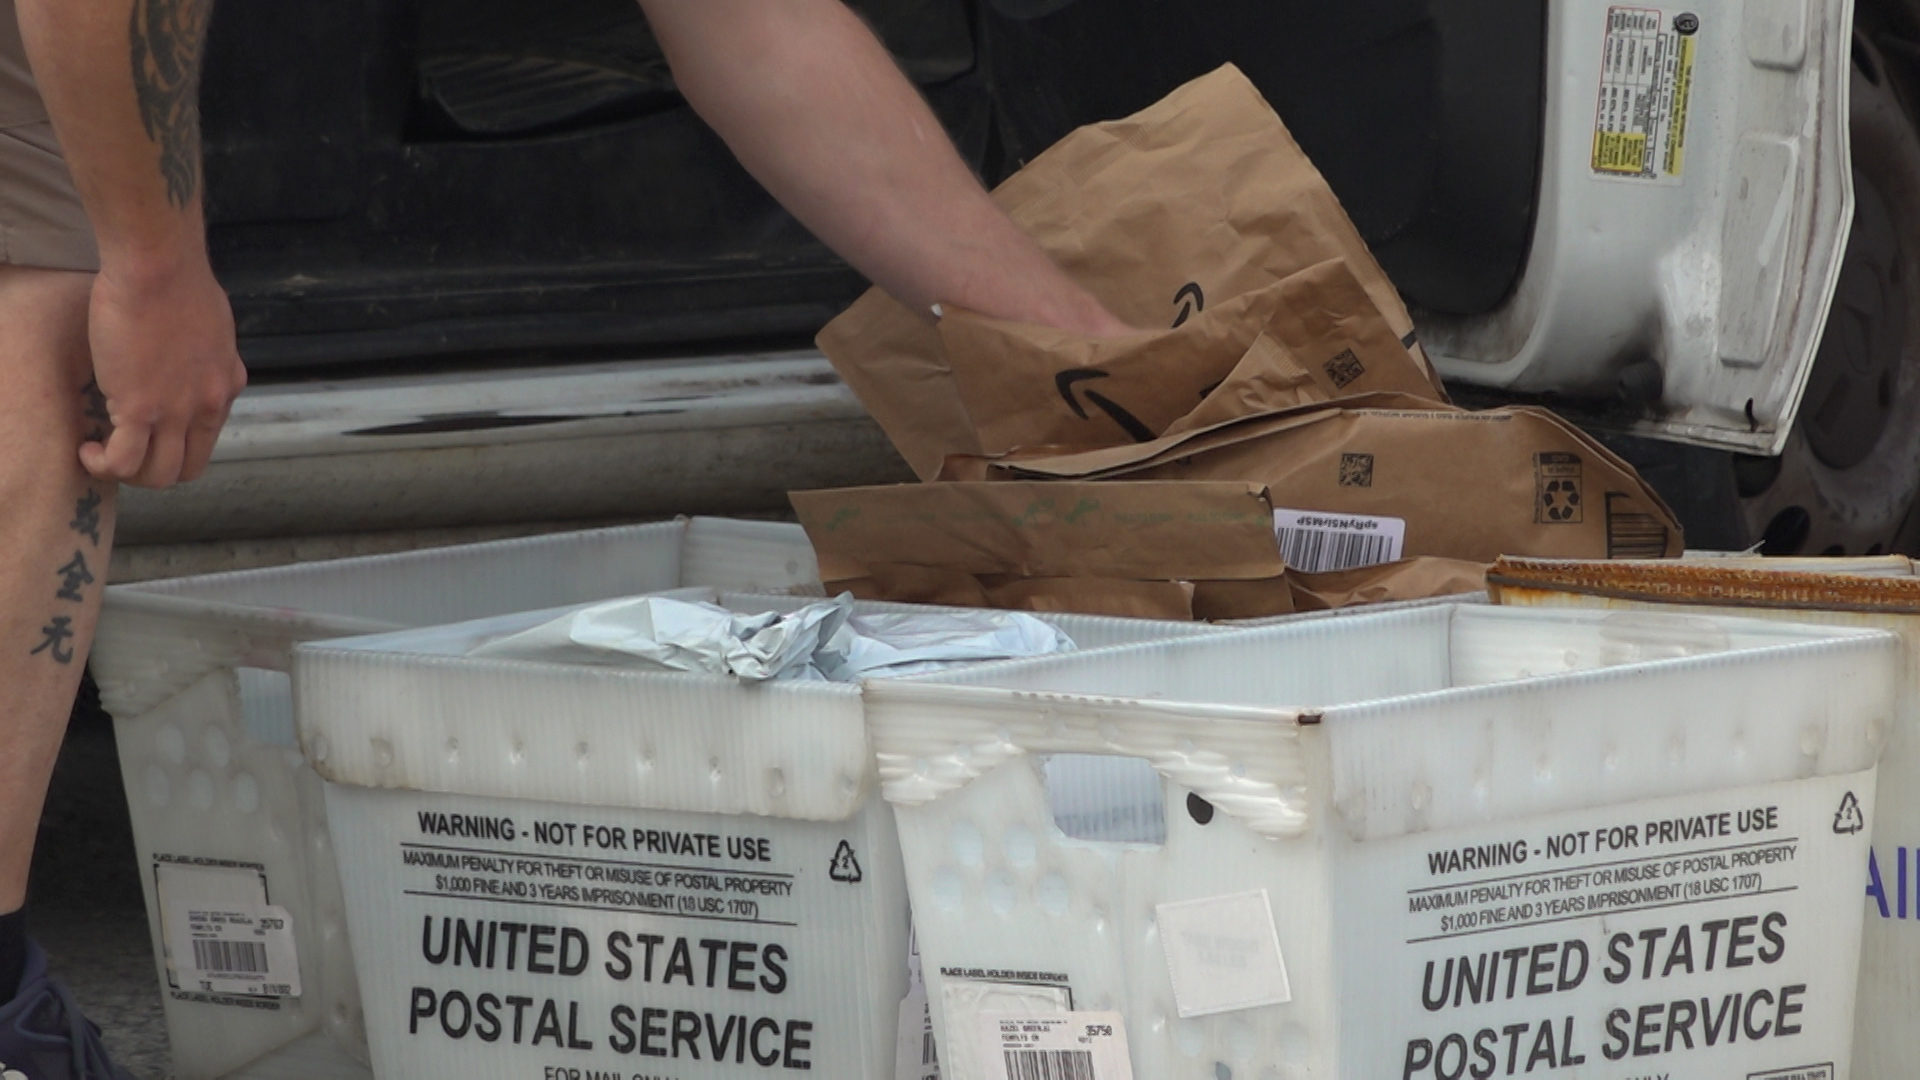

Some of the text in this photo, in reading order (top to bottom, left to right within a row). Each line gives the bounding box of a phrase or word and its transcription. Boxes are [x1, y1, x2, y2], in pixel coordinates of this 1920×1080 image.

[417, 810, 516, 841] WARNING
[534, 820, 577, 846] NOT
[583, 825, 628, 851] FOR
[633, 828, 721, 858] PRIVATE
[727, 836, 771, 862] USE
[1428, 839, 1527, 875] WARNING
[1547, 831, 1590, 859] NOT
[1595, 825, 1639, 851] FOR
[1645, 812, 1731, 845] PRIVATE
[1737, 806, 1779, 833] USE
[403, 851, 793, 896] MAXIMUM PENALTY FOR THEFT OR MISUSE OF POSTAL PROPERTY
[435, 873, 471, 892] $1,000
[473, 878, 500, 894] FINE
[501, 881, 527, 897] AND
[529, 883, 537, 898] 3
[539, 884, 580, 901] YEARS
[582, 887, 675, 909] IMPRISONMENT
[698, 897, 725, 913] USC
[727, 899, 759, 920] 1707)
[1409, 846, 1797, 913] MAXIMUM PENALTY FOR THEFT OR MISUSE OF POSTAL PROPERTY
[1440, 872, 1762, 932] $1,000 FINE AND 3 YEARS IMPRISONMENT (18 USC 1707)
[1866, 845, 1920, 919] AI
[422, 914, 788, 994] UNITED STATES
[940, 967, 1069, 982] PLACE LABEL HOLDER INSIDE BORDER
[1422, 911, 1788, 1012] UNITED STATES
[409, 986, 813, 1070] POSTAL SERVICE
[1085, 1025, 1112, 1036] 35750
[1402, 983, 1807, 1080] POSTAL SERVICE
